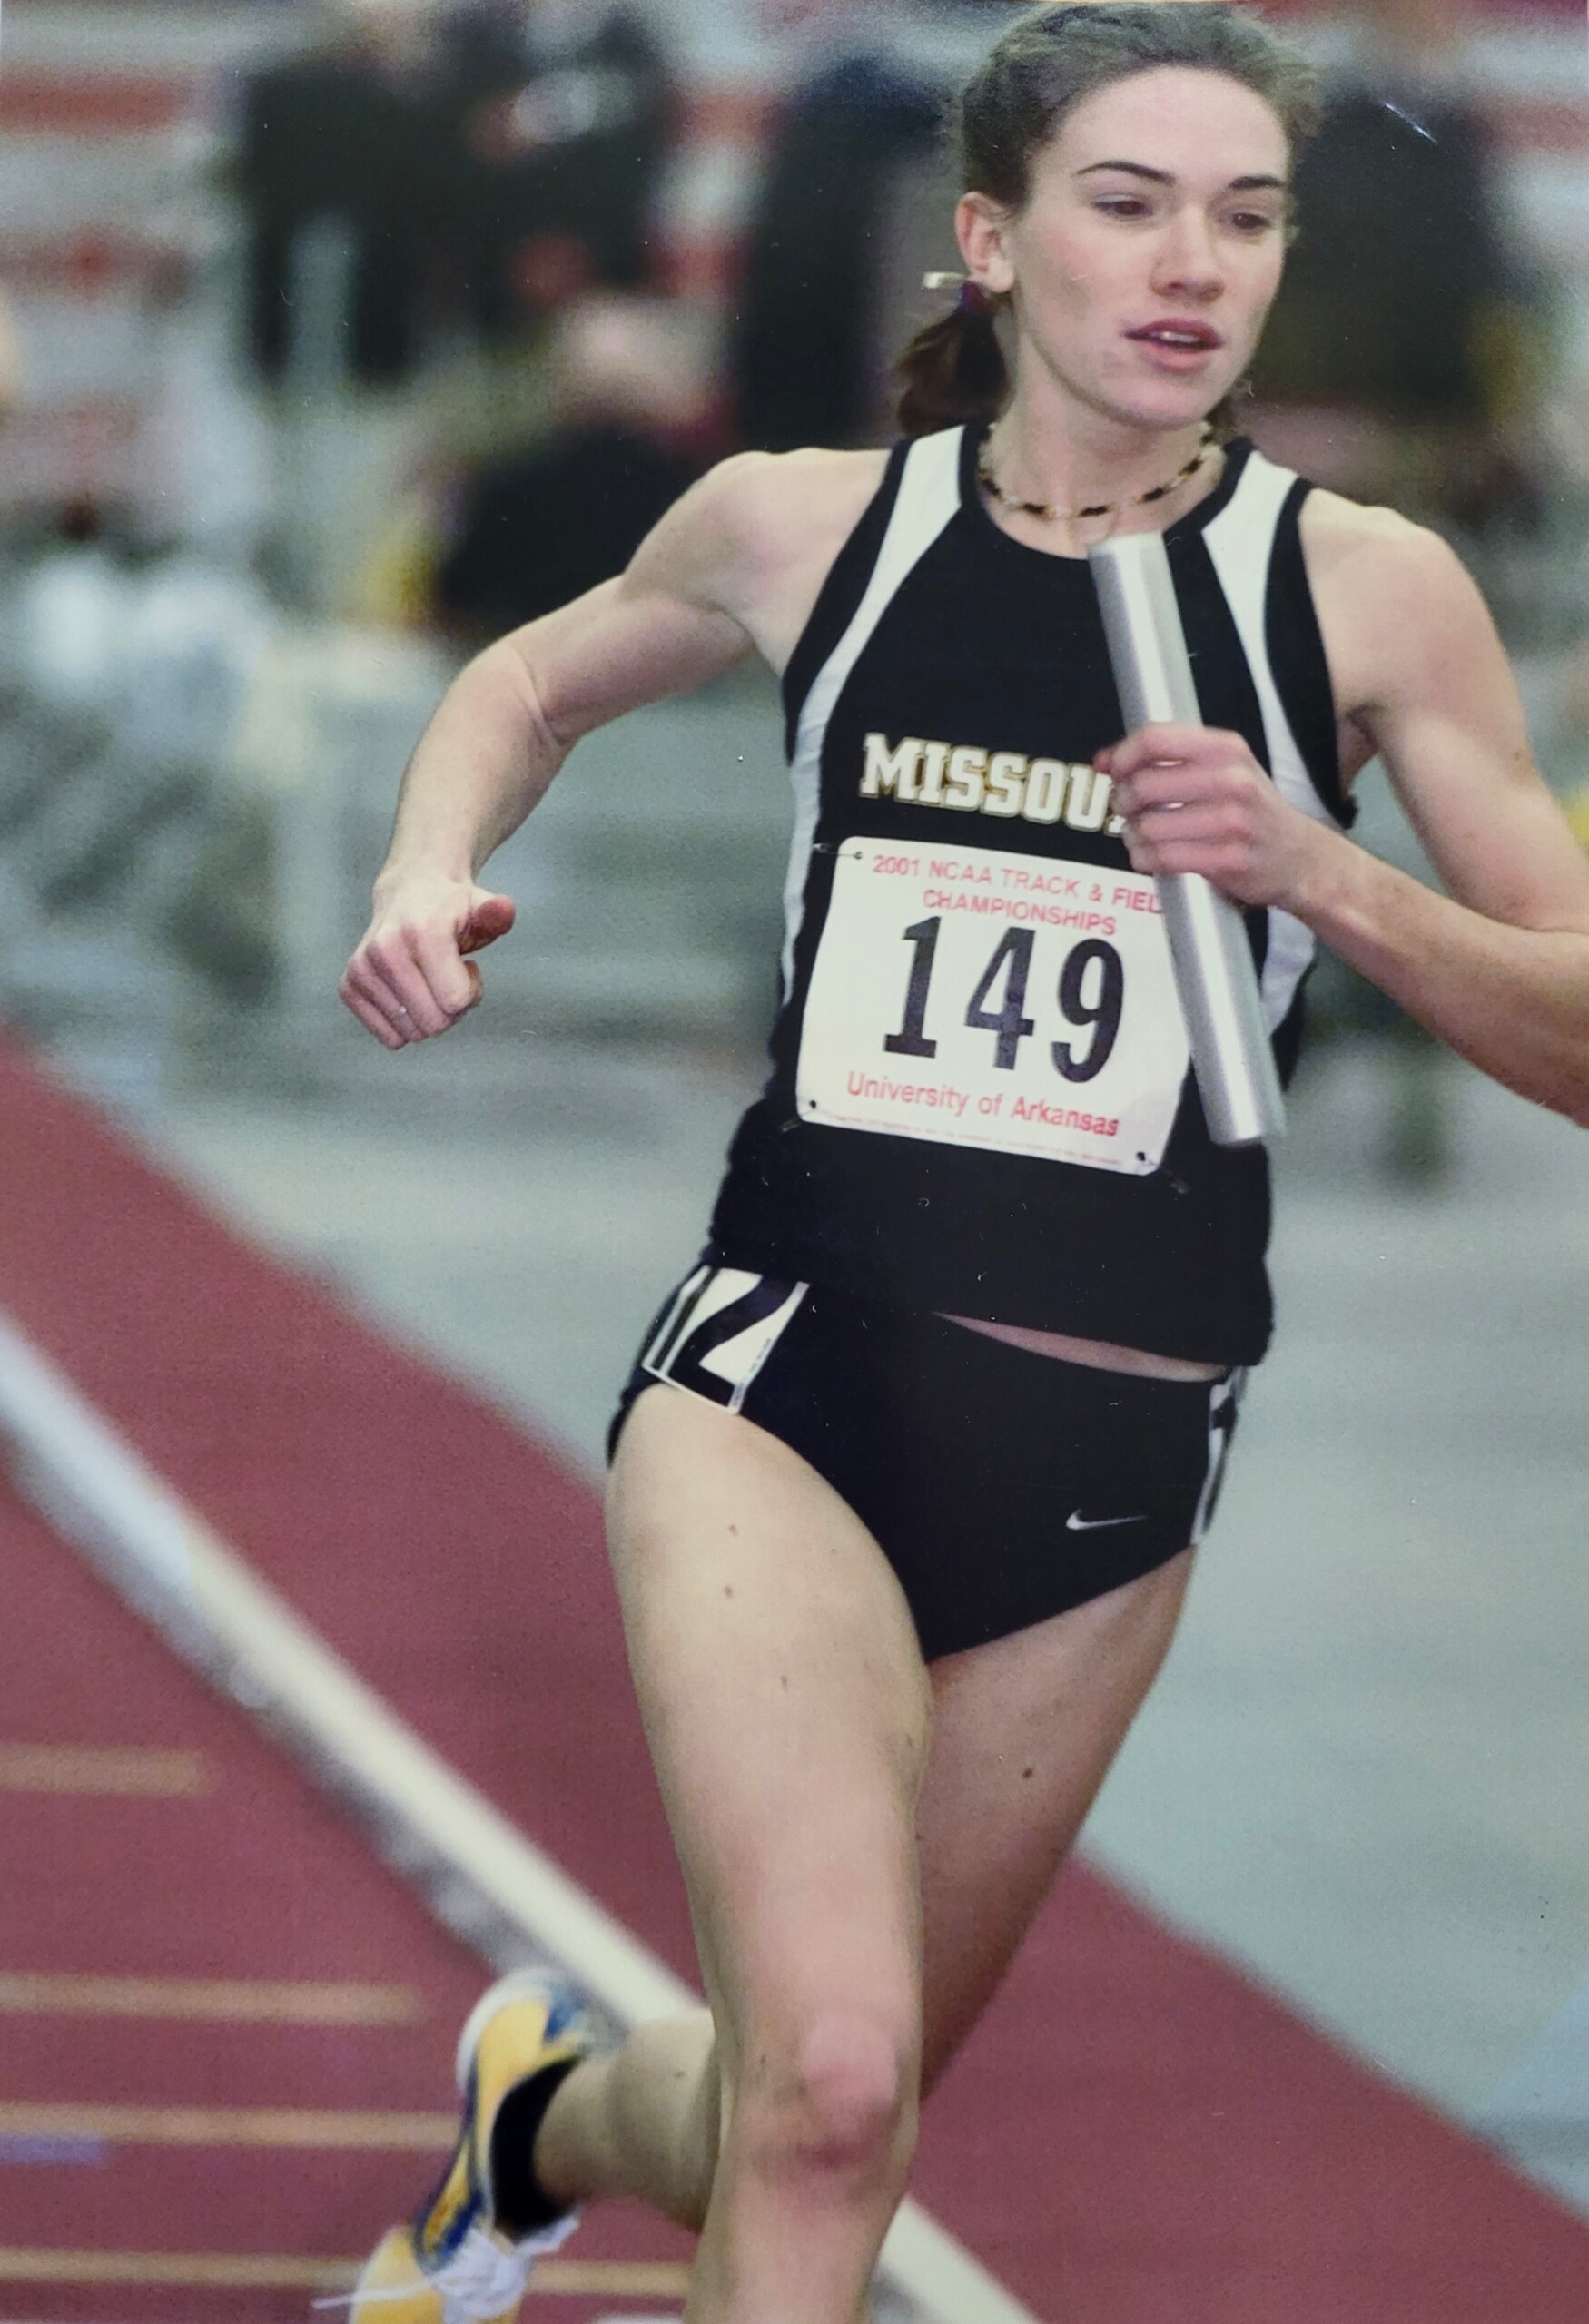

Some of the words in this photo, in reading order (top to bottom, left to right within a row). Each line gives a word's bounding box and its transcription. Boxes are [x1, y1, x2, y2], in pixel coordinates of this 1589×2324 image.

[859, 731, 1127, 837] MISSOU
[873, 854, 920, 877] 2001
[929, 860, 992, 884] NCAA
[1002, 868, 1081, 898] TRACK
[1089, 883, 1103, 902] &
[1111, 887, 1162, 915] FIEL
[923, 889, 1117, 936] CHAMPIONSHIPS
[883, 914, 1125, 1084] 149
[846, 1070, 969, 1118] University
[978, 1092, 1003, 1116] of
[1010, 1095, 1120, 1137] Arkansas
